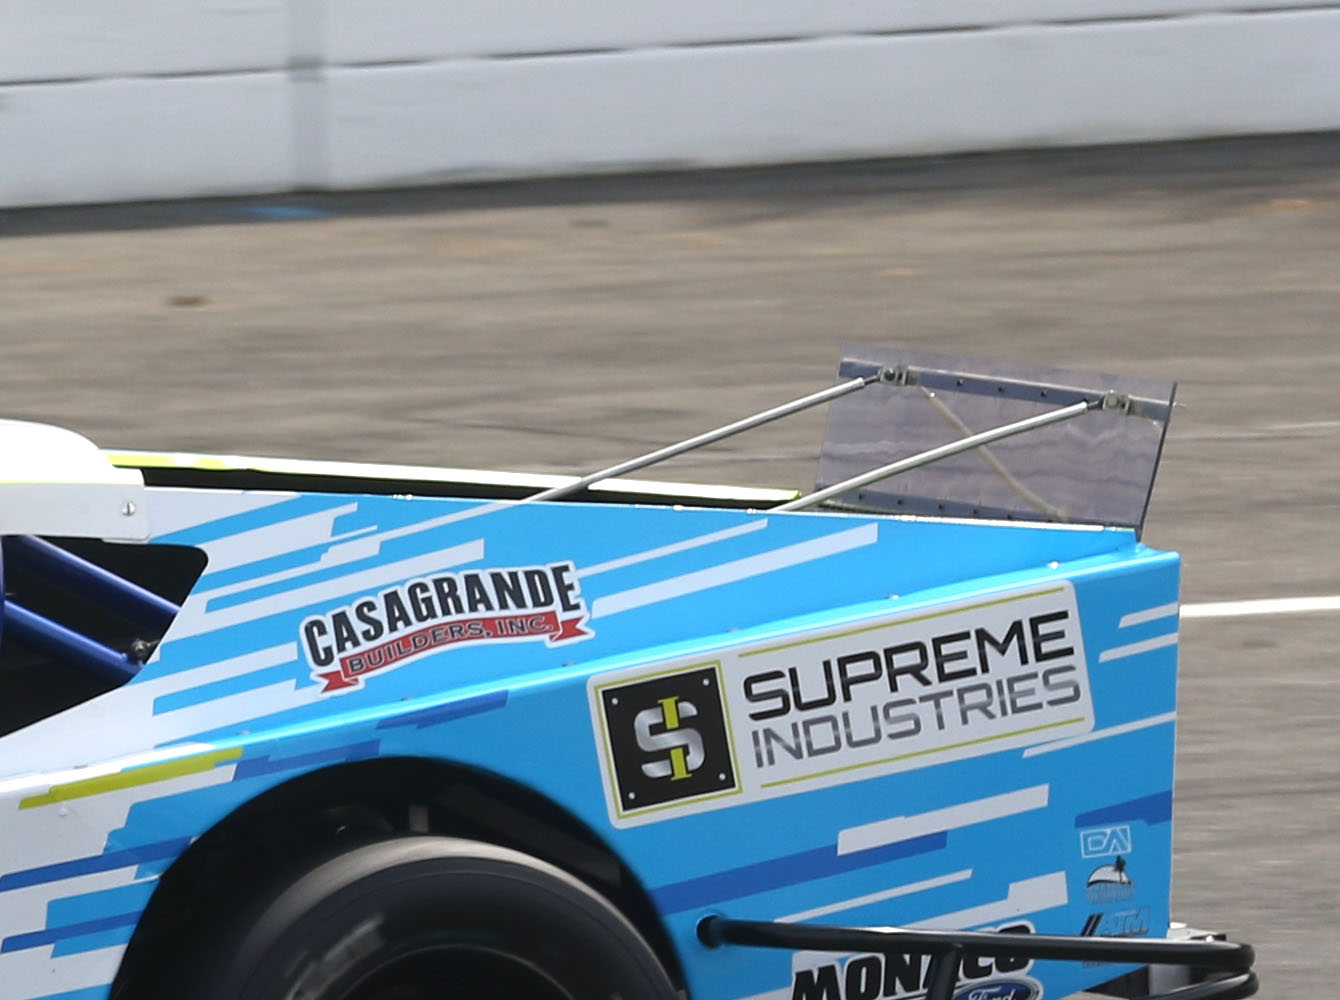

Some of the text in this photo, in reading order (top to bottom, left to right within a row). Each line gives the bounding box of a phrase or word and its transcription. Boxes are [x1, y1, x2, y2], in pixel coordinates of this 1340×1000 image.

[304, 564, 582, 668] CASAGRANDE
[348, 615, 554, 674] BUILDERS, INC.
[742, 609, 1076, 722] SUPREME
[750, 664, 1082, 768] INDUSTRIES
